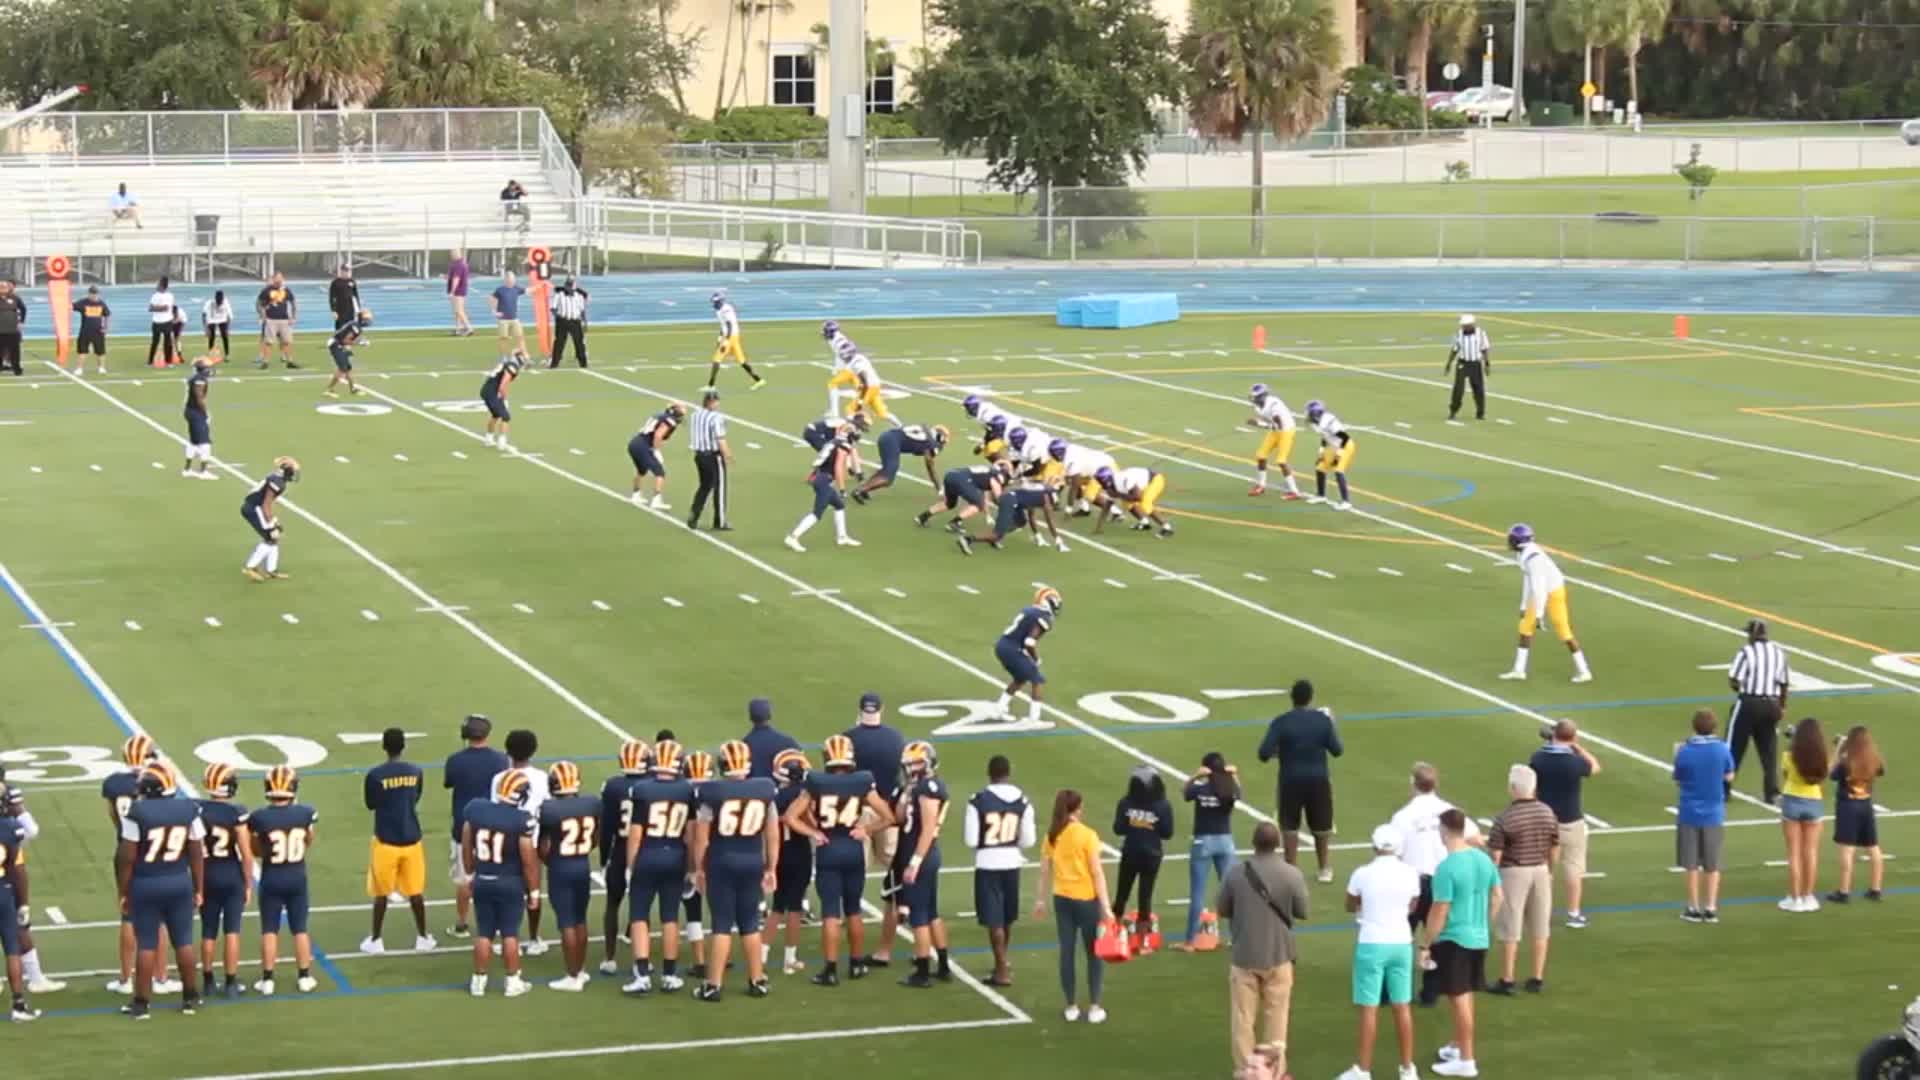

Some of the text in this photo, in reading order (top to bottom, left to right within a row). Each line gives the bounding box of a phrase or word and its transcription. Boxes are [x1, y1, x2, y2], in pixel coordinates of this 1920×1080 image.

[898, 690, 1211, 735] 20
[646, 801, 689, 838] 50
[717, 798, 766, 837] 60
[819, 794, 860, 829] 54
[984, 811, 1018, 845] 20
[144, 826, 188, 863] 79
[269, 829, 307, 864] 30
[475, 828, 505, 864] 61
[559, 815, 595, 856] 23
